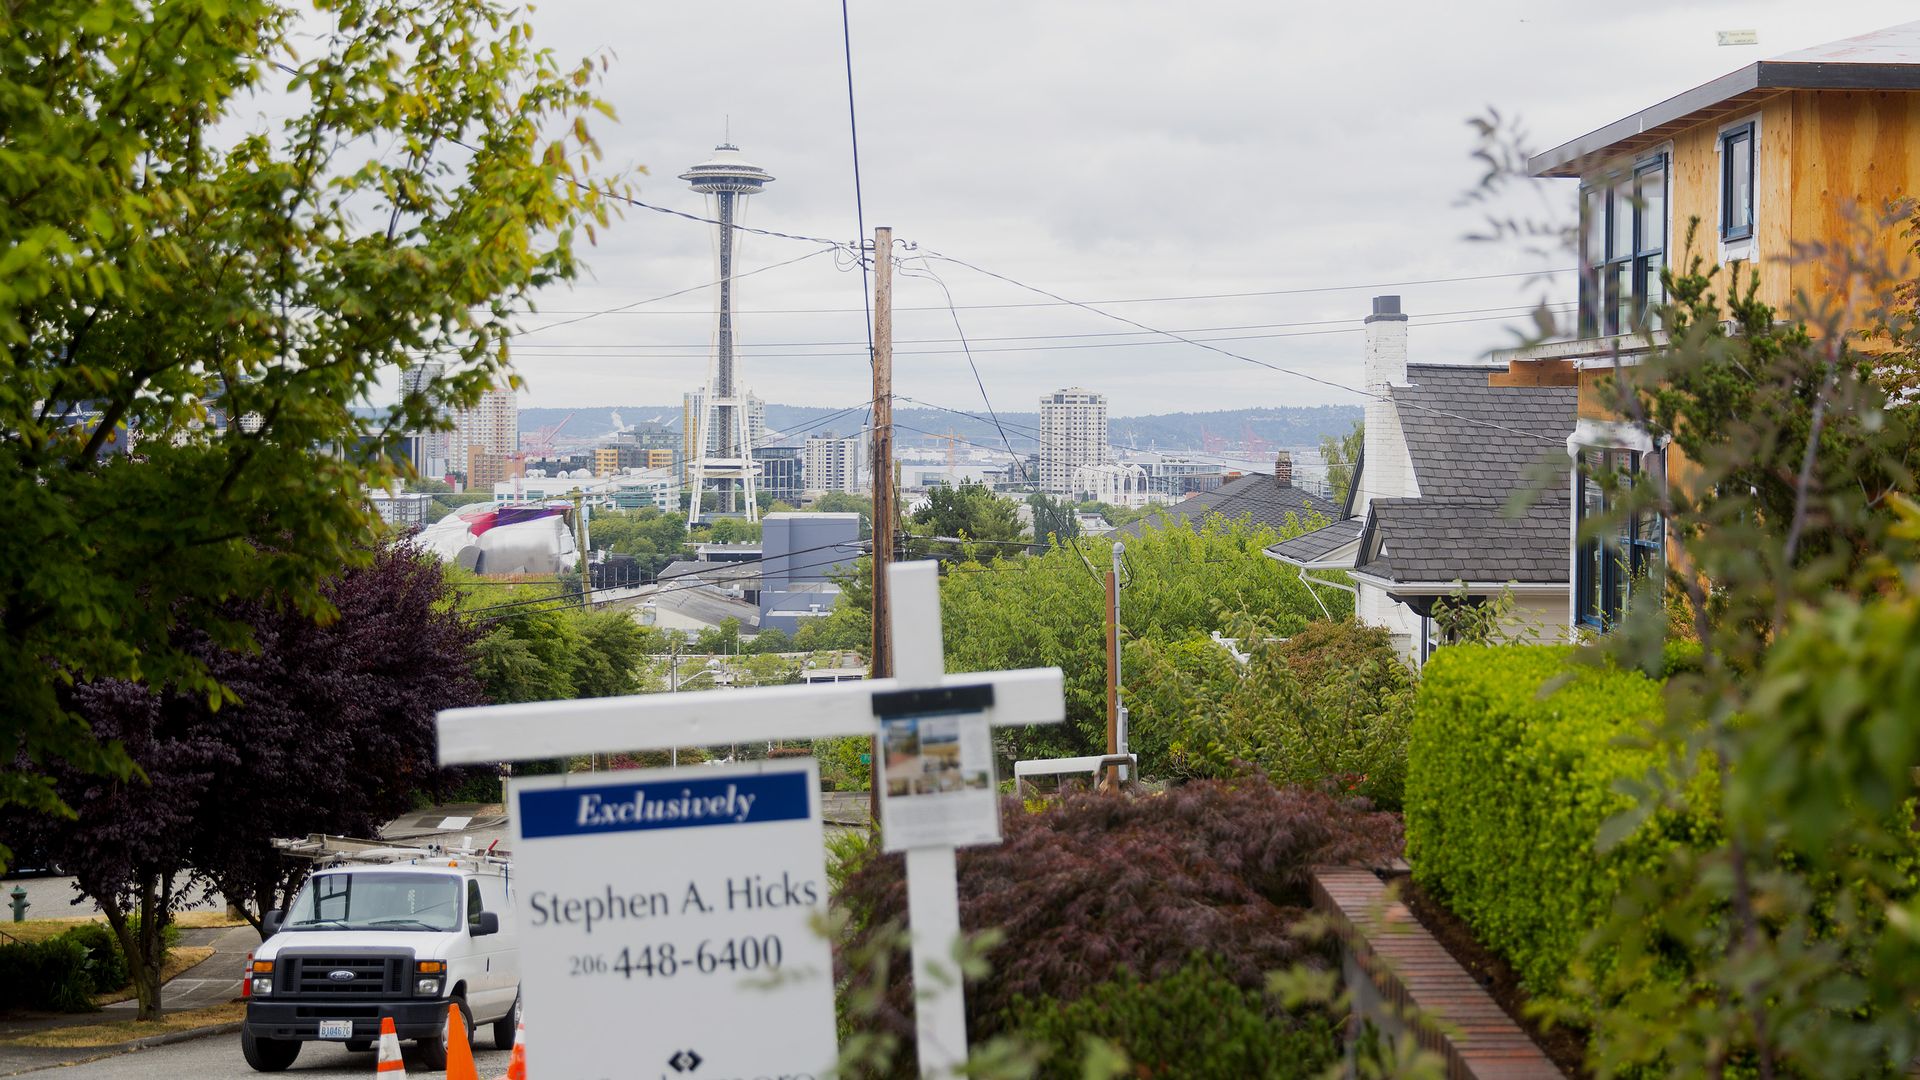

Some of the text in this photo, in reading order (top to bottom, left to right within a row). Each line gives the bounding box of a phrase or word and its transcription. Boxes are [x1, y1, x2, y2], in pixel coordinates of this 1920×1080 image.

[577, 784, 756, 825] Exclusively
[530, 871, 818, 933] Stephen A. Hicks
[569, 934, 783, 979] 206 448-6400
